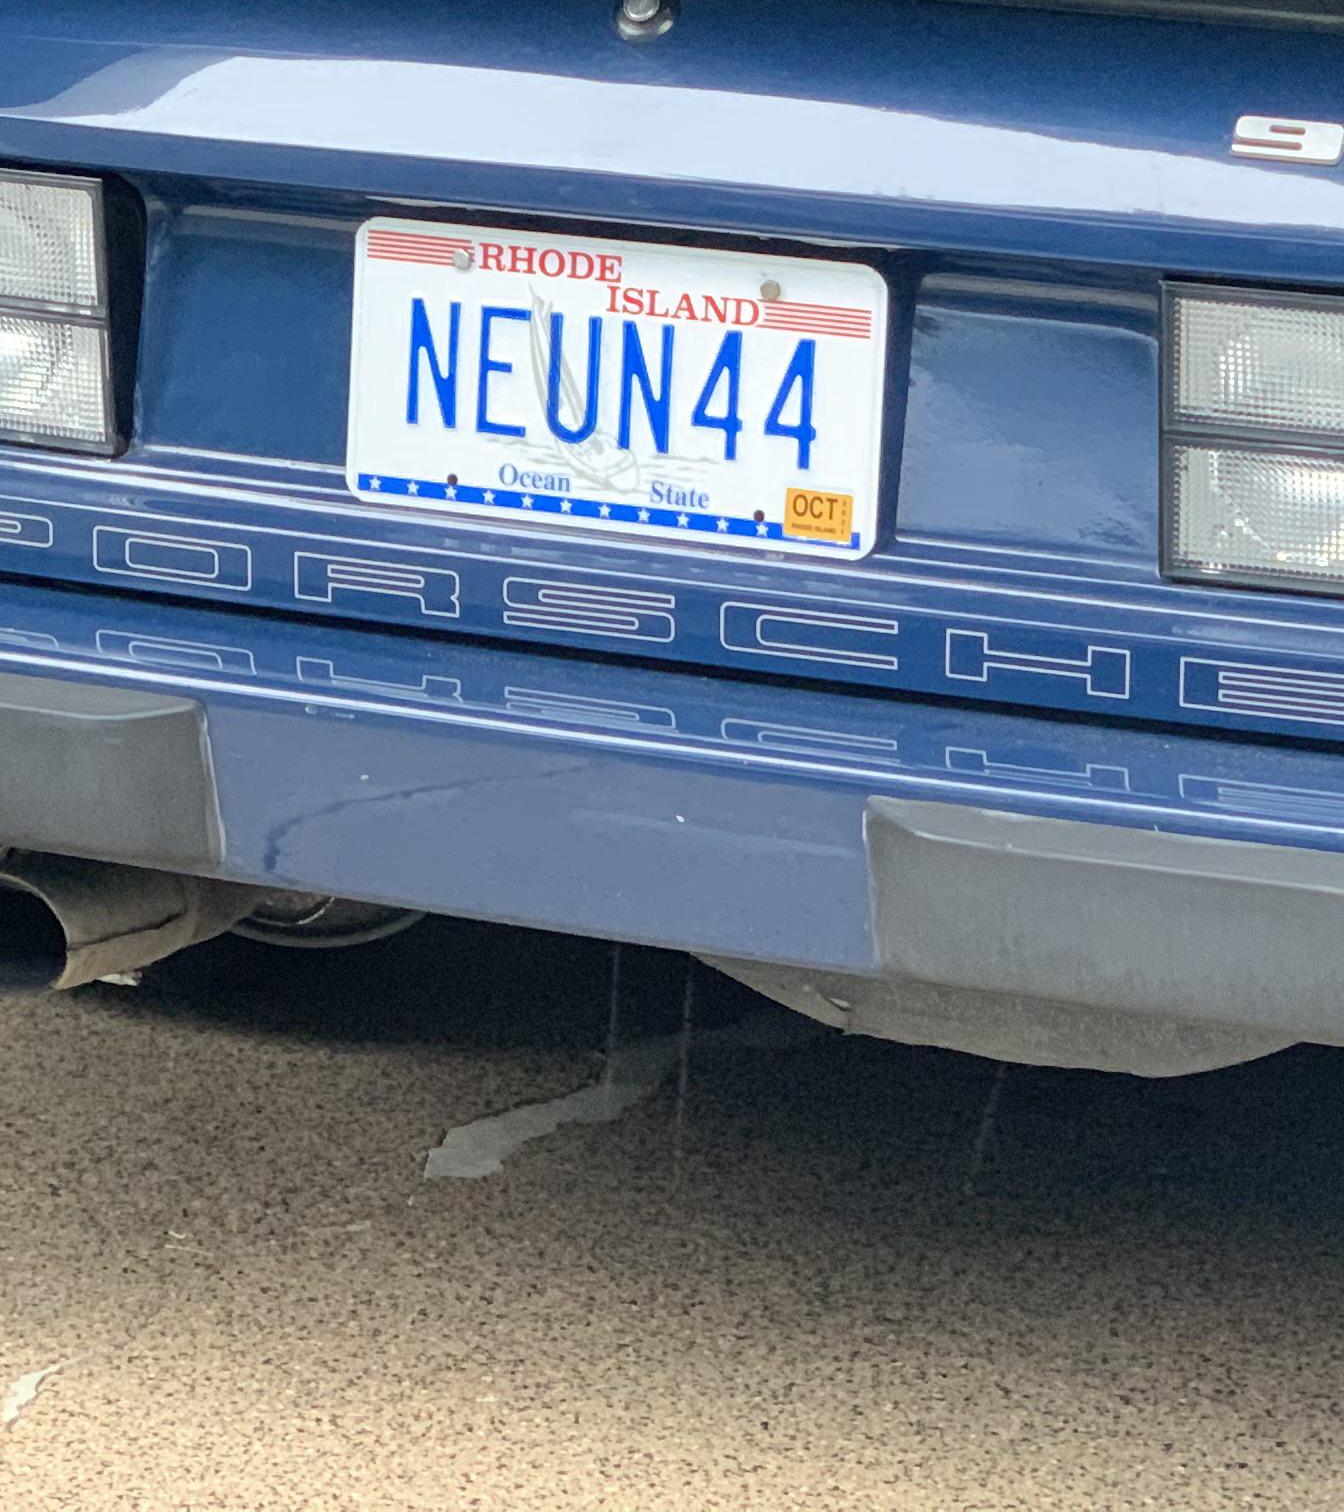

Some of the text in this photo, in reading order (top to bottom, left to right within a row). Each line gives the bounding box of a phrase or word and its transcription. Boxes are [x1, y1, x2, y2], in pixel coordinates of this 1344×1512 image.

[479, 242, 623, 283] RHODE
[607, 286, 760, 326] ISLAND
[406, 297, 816, 470] NEUN44
[498, 463, 710, 509] Ocean State
[792, 494, 838, 520] OCT
